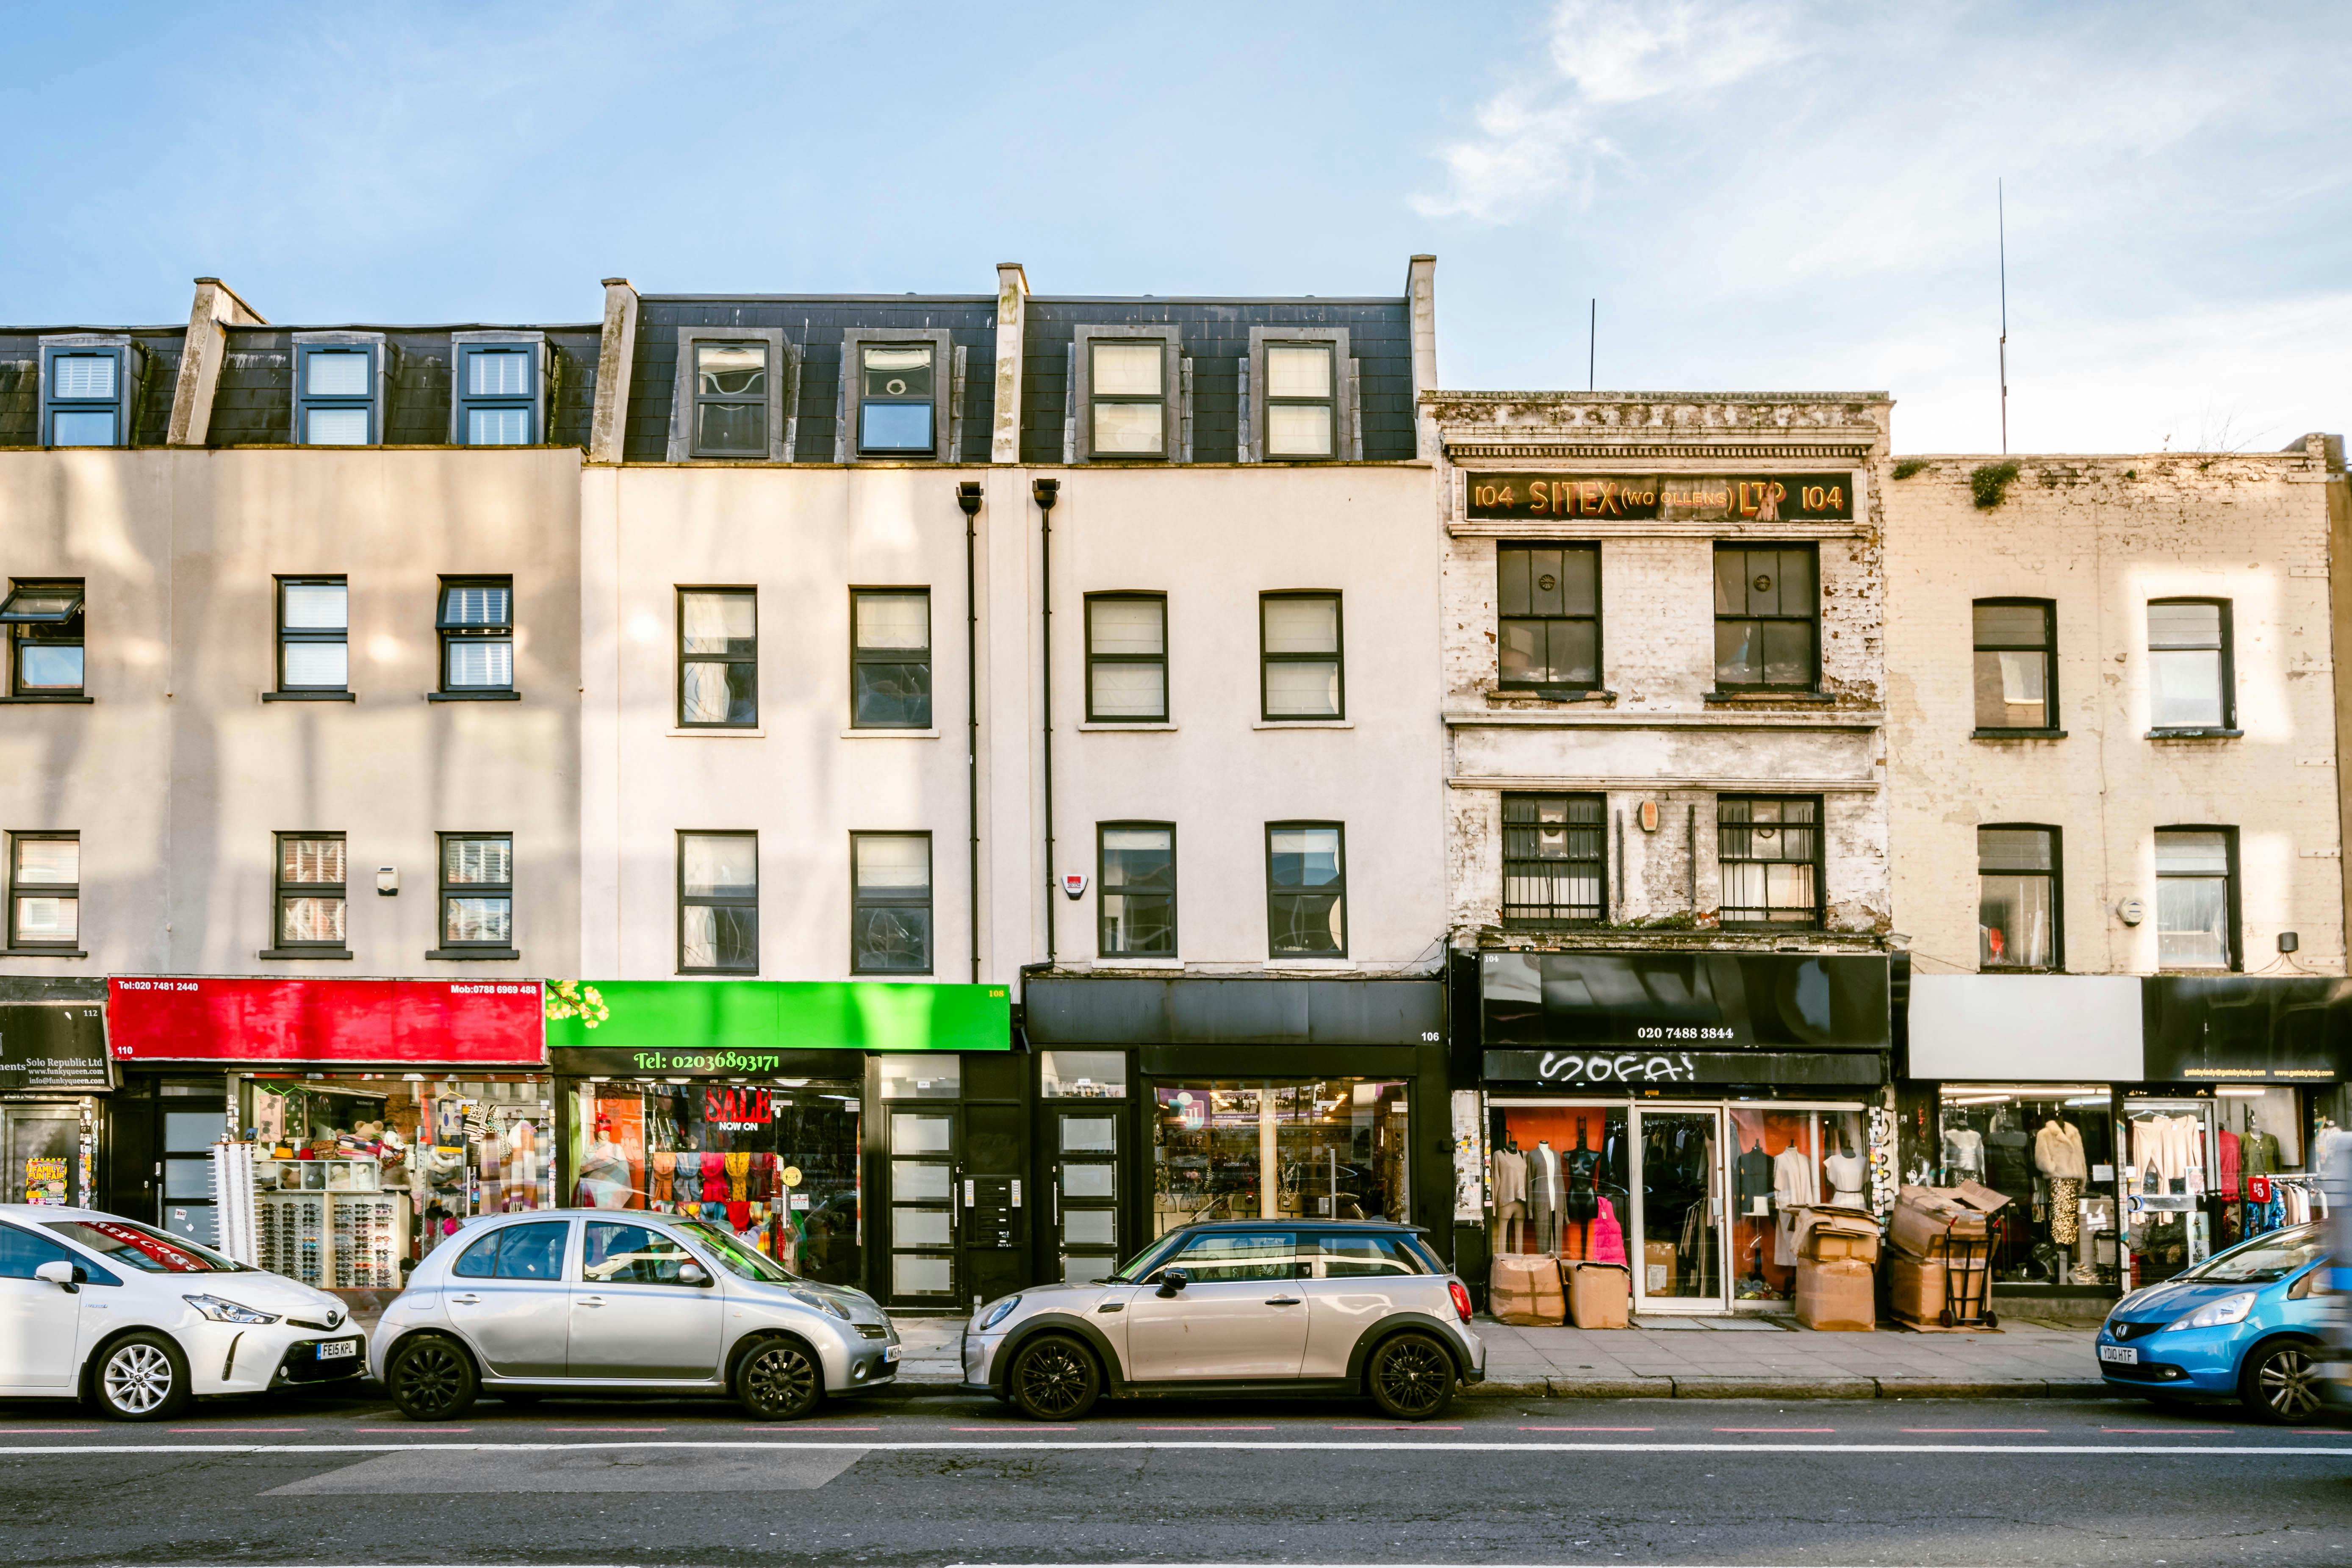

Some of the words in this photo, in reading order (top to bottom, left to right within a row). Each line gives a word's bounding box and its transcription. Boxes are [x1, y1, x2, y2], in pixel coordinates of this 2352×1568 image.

[1476, 486, 1513, 508] 104
[1529, 482, 1622, 515] SITEX
[1803, 486, 1845, 511] 104
[118, 981, 151, 990] Tel:020
[153, 982, 174, 990] 7481
[177, 983, 198, 991] 2440
[451, 985, 495, 993] Mob:0788
[497, 986, 518, 994] 6969
[520, 986, 536, 994] 488
[1421, 1032, 1439, 1041] 106
[1637, 1027, 1662, 1038] 020
[1665, 1028, 1697, 1039] 7488
[1701, 1028, 1734, 1039] 3844
[117, 1046, 133, 1054] 110
[27, 1058, 45, 1067] Solo
[47, 1058, 86, 1068] Republic
[88, 1058, 103, 1067] Ltd
[634, 1052, 666, 1069] Tel:
[672, 1051, 778, 1072] 02036893171
[28, 1068, 104, 1076] www.funkyqueen.com
[29, 1077, 105, 1085] info@funkyqueen.com
[706, 1085, 771, 1123] SALE
[719, 1122, 741, 1131] NOW
[743, 1122, 758, 1131] ON
[32, 1165, 61, 1173] FAMILY
[28, 1172, 44, 1180] FUN
[46, 1172, 65, 1180] FAIR
[2253, 1182, 2264, 1197] £5
[324, 1344, 339, 1356] FE15
[341, 1342, 353, 1354] KPL
[2104, 1348, 2117, 1360] YD10
[2118, 1349, 2132, 1361] HTF
